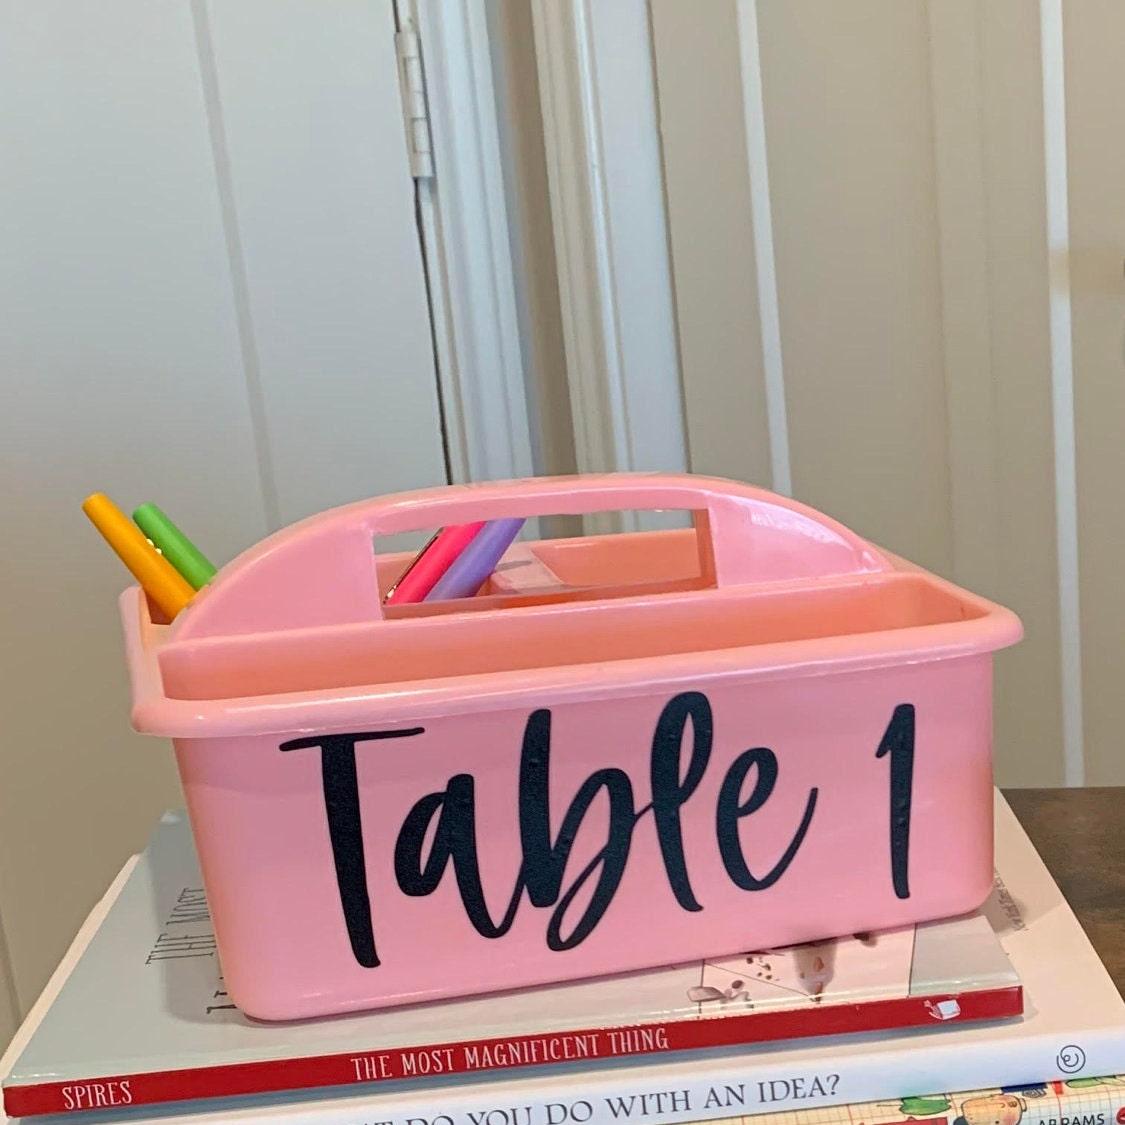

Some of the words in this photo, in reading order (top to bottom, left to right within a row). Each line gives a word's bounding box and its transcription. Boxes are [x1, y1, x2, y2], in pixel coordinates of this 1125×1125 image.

[279, 691, 818, 968] Table
[876, 703, 914, 900] 1
[61, 1080, 133, 1110] SPIRES
[350, 1055, 393, 1081] THE
[400, 1048, 455, 1076] MOST
[463, 1034, 600, 1069] MAGNIFICENT
[606, 1027, 670, 1055] THING
[545, 1099, 593, 1125] DO
[603, 1089, 692, 1119] WITH
[704, 1084, 745, 1109] AN
[757, 1074, 840, 1103] IDEA?
